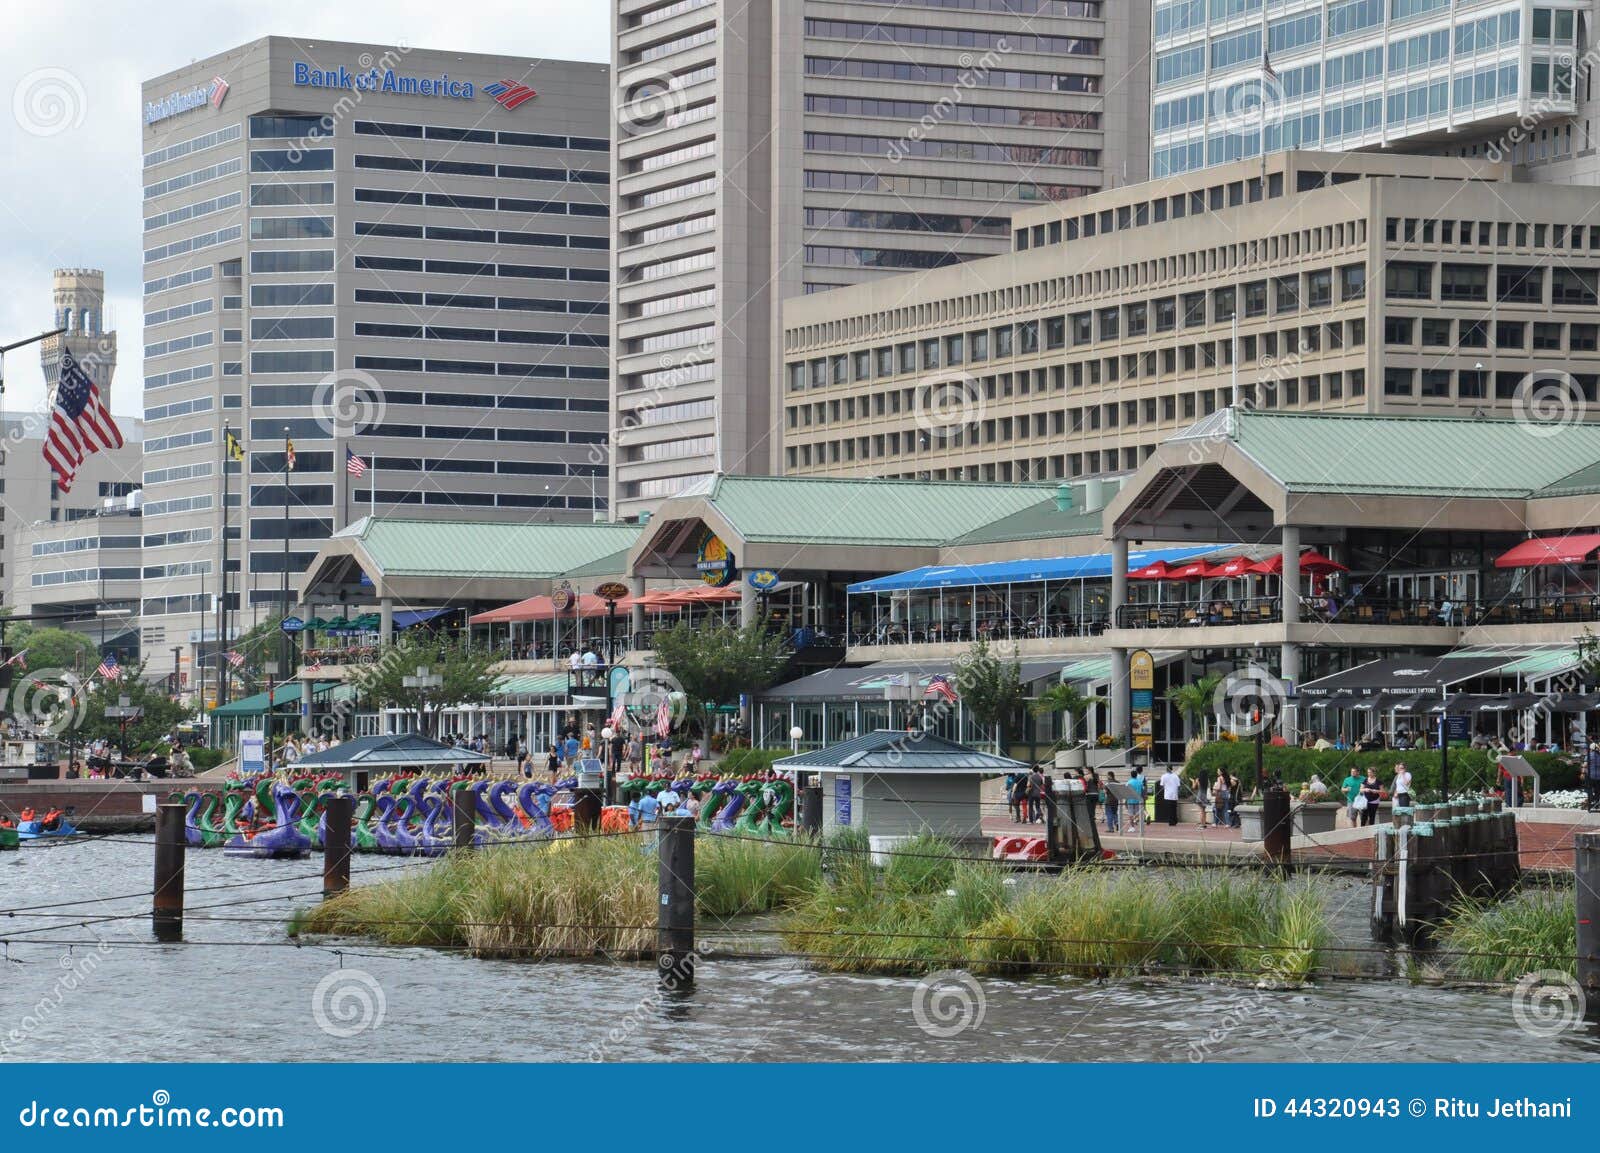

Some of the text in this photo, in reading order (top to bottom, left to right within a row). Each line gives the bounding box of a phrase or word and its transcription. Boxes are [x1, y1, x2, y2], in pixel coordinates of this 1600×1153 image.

[294, 62, 475, 98] Bank of America
